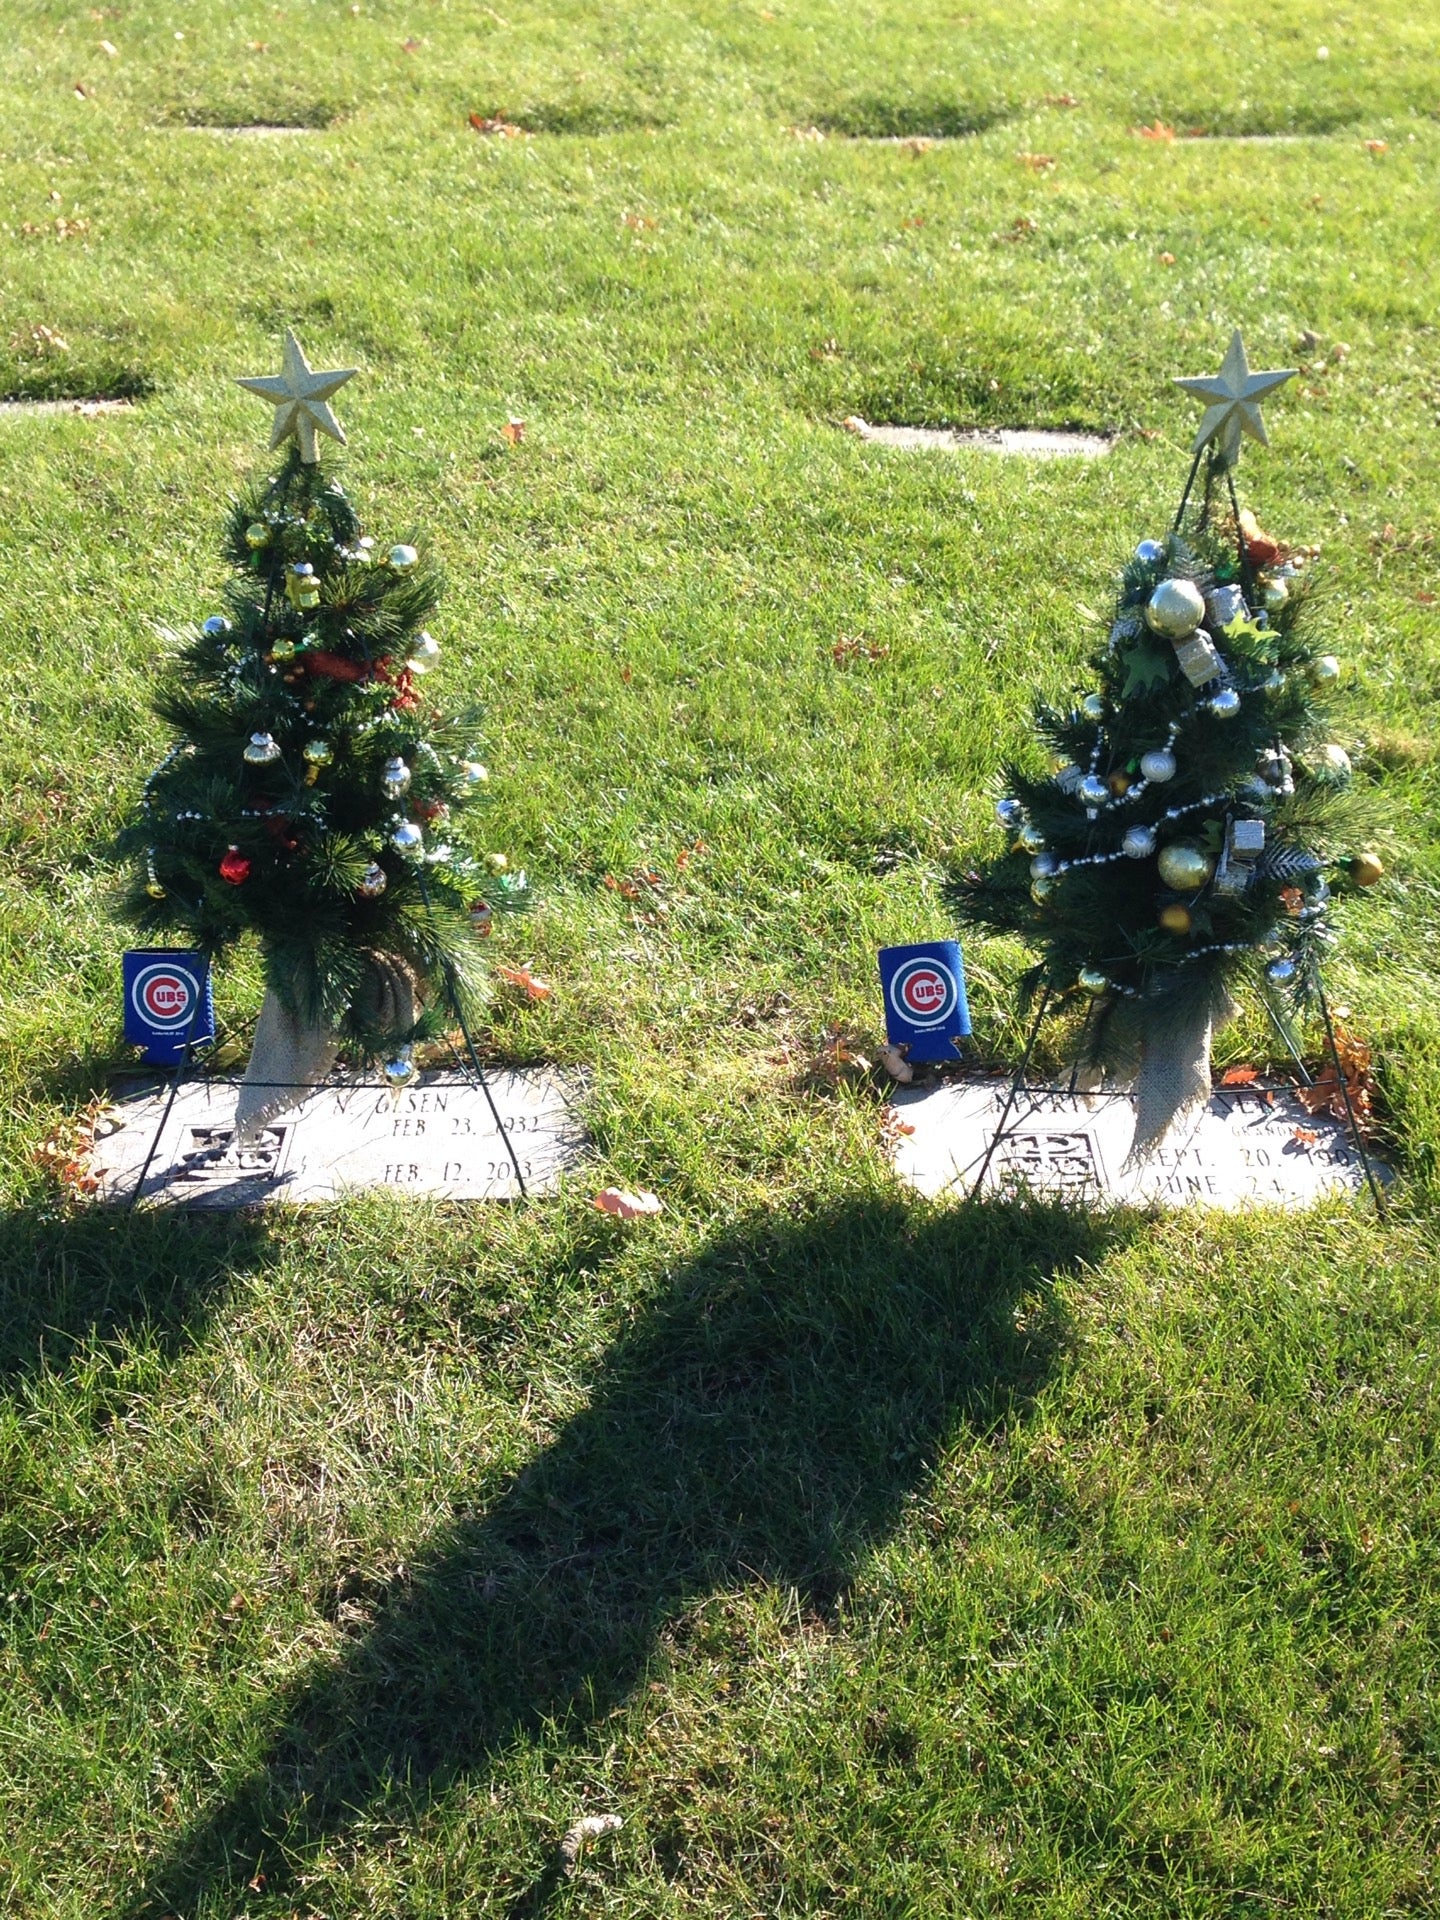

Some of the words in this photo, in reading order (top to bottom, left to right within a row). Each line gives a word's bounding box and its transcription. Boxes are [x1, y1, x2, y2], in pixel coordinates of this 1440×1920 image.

[146, 977, 186, 1016] CUBS
[905, 972, 944, 1011] CUBS
[375, 1093, 449, 1114] OLSEN
[1305, 1148, 1351, 1168] 190
[384, 1163, 424, 1183] FEB.
[486, 1161, 533, 1181] 203
[1155, 1175, 1222, 1195] JUNE
